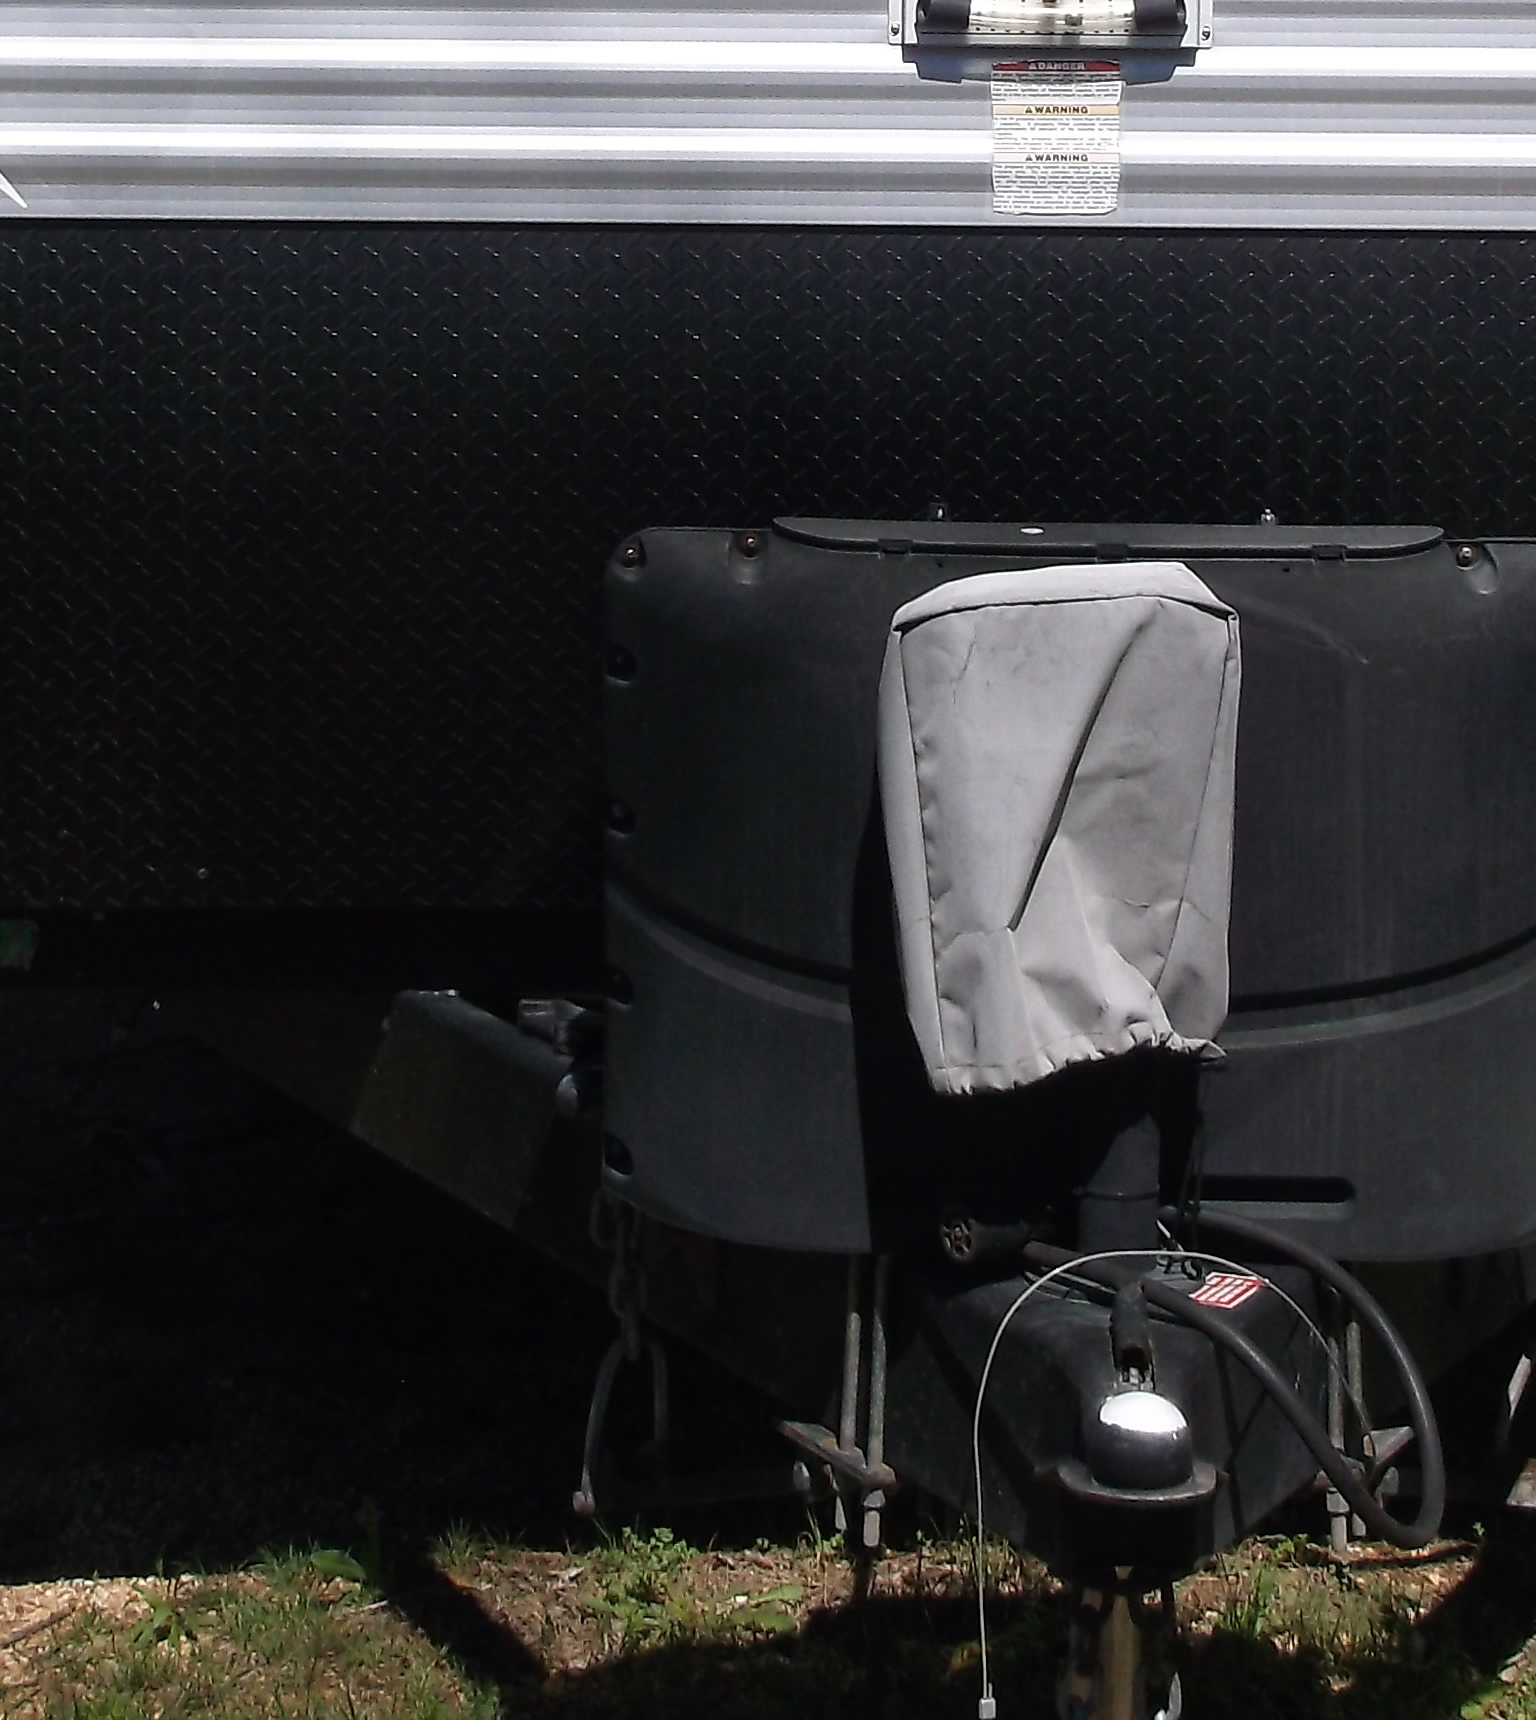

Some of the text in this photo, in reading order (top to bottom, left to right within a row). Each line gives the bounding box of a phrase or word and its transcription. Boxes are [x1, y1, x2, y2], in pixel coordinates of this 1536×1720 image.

[1037, 62, 1085, 71] DANGER
[1035, 106, 1089, 114] WARNING
[1035, 154, 1089, 162] WARNING
